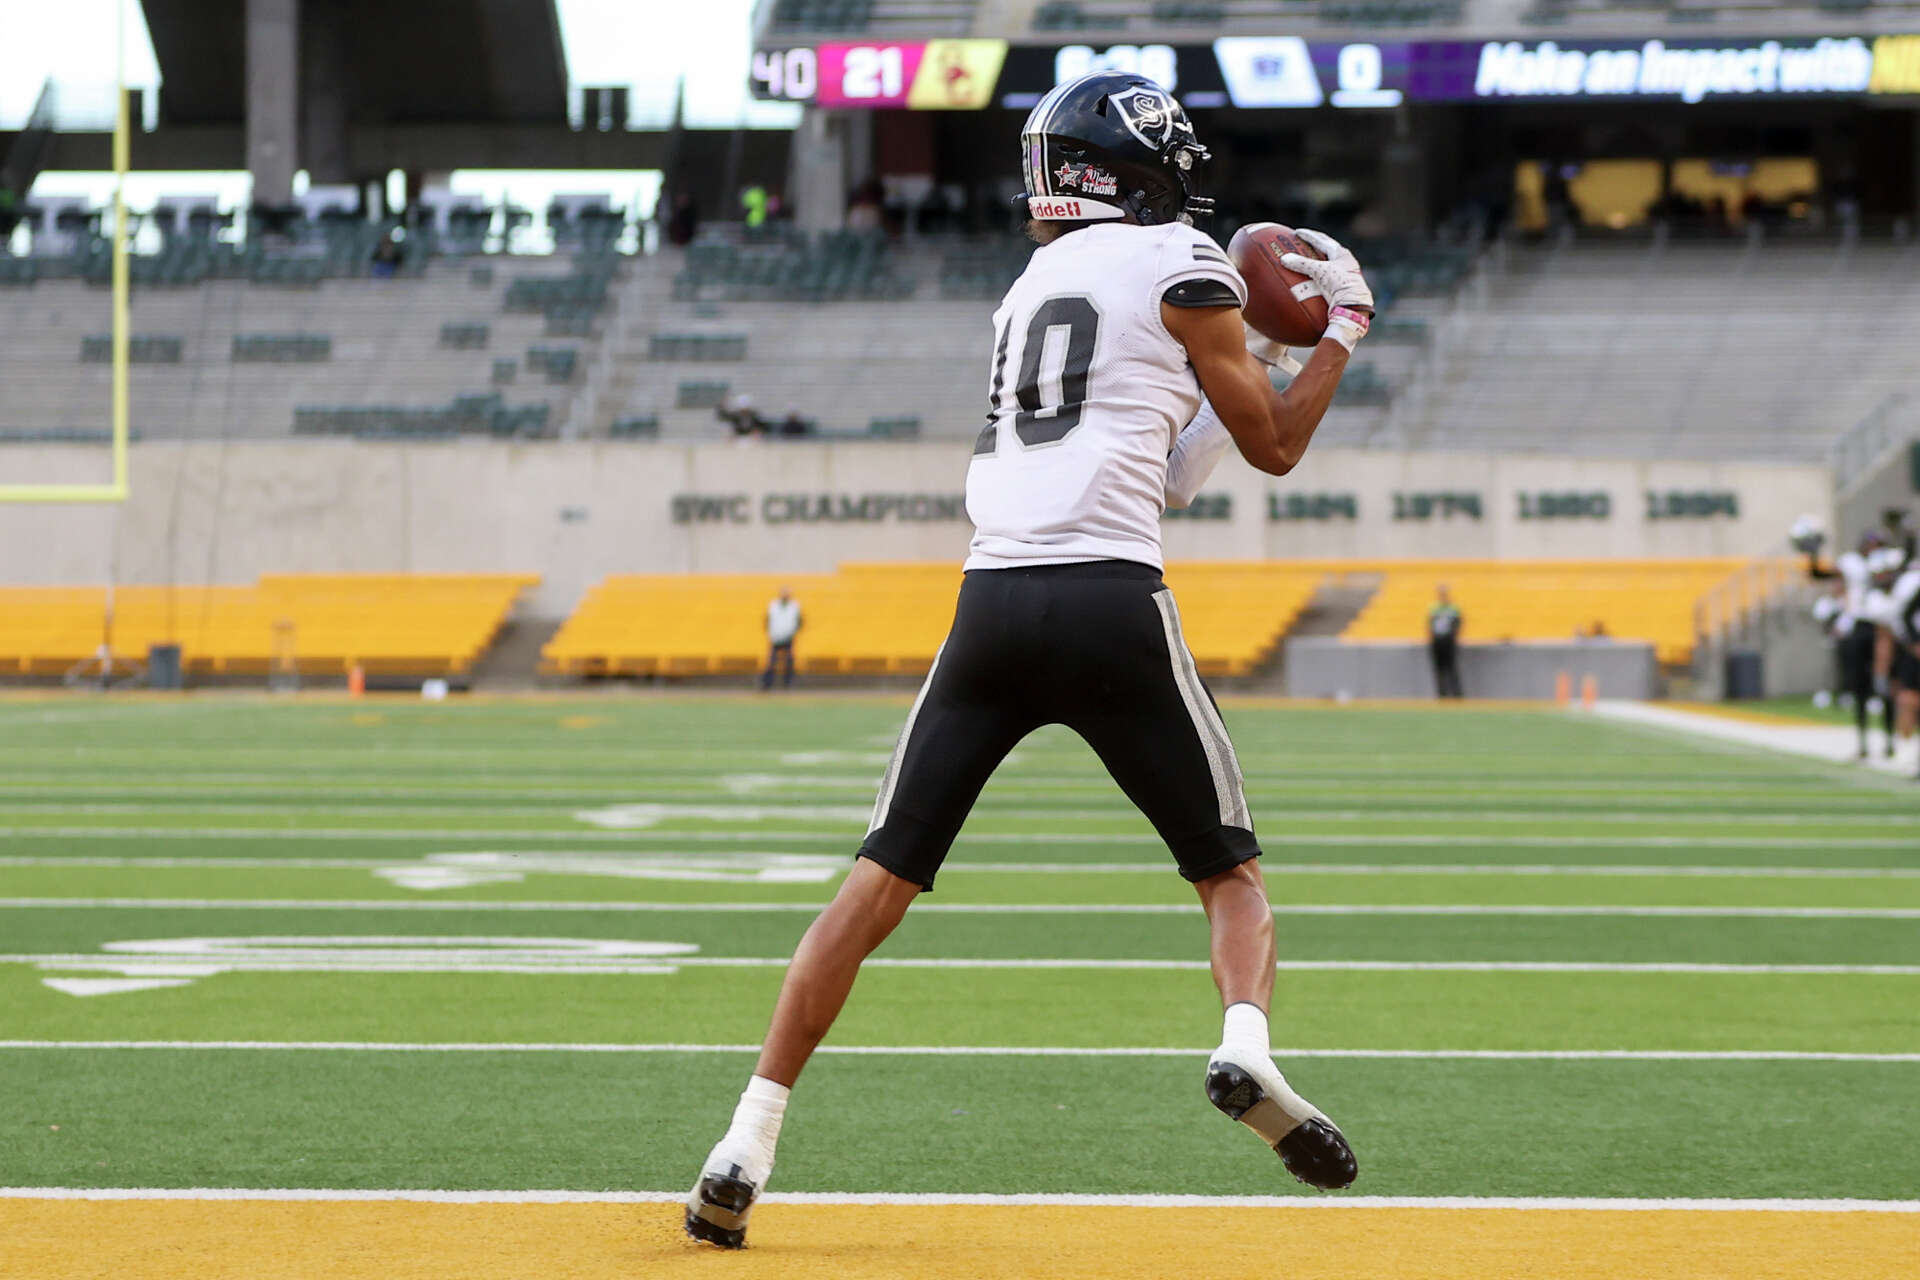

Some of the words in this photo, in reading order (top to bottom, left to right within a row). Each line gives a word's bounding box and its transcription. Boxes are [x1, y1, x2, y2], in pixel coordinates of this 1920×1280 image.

[751, 48, 817, 99] 40
[843, 46, 902, 97] 21
[1475, 41, 1587, 96] Make
[1584, 50, 1641, 94] an
[1638, 39, 1781, 104] Impact
[1779, 37, 1872, 92] with
[1081, 181, 1118, 197] STRONG
[761, 493, 965, 521] CHAMPION
